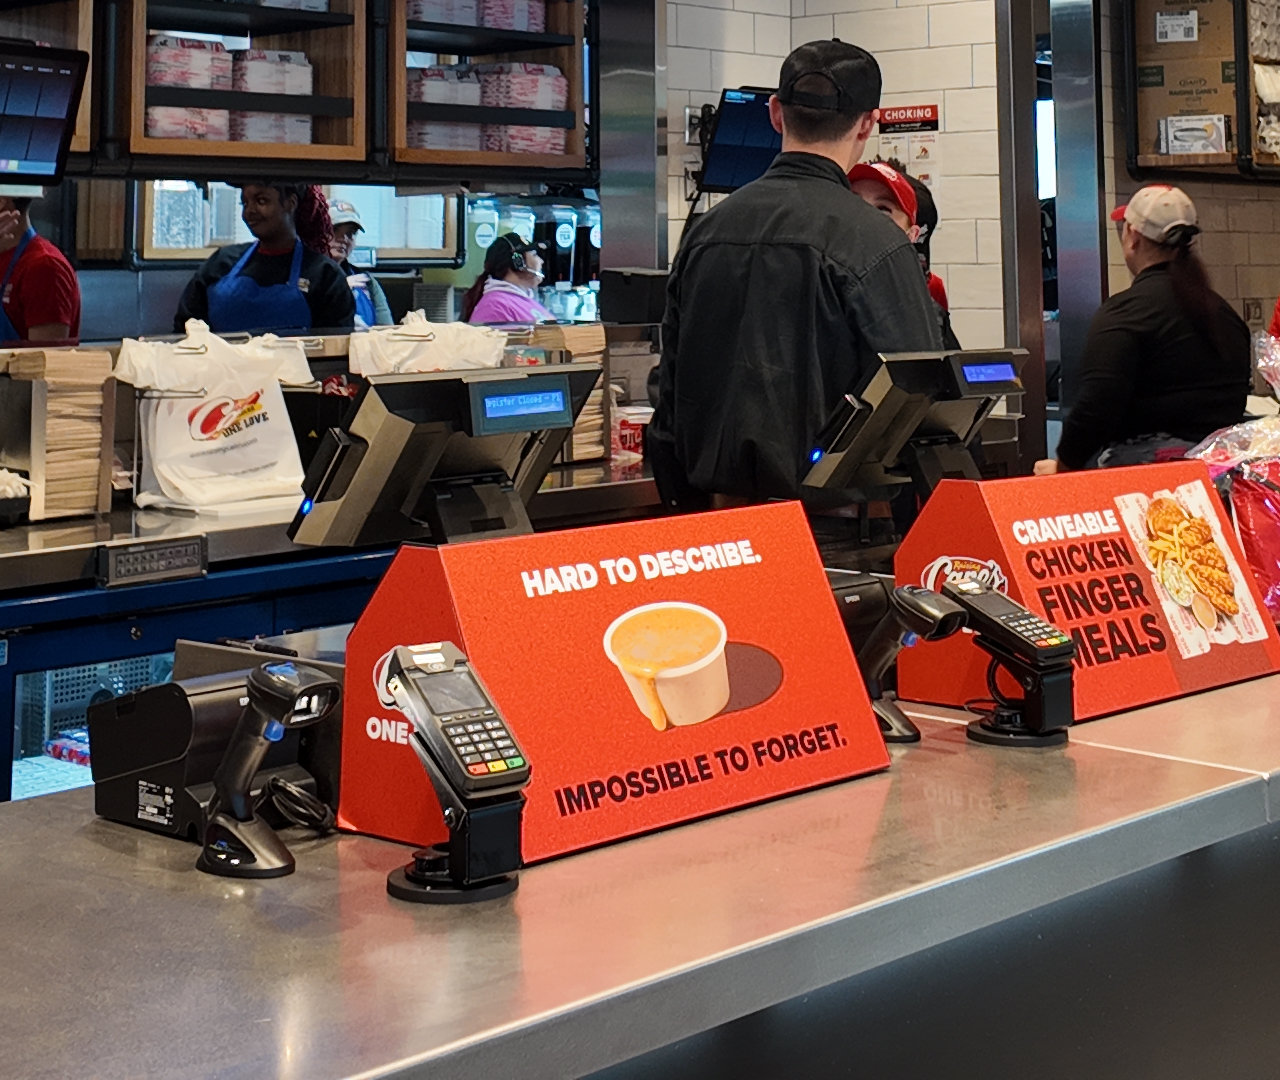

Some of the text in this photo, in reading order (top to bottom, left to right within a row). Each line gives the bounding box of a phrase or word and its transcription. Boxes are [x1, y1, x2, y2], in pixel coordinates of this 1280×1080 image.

[884, 108, 932, 120] CHOKING
[244, 411, 269, 428] LOVE
[485, 398, 514, 408] egister
[1012, 509, 1121, 546] CRAVEABLE
[521, 539, 762, 598] HARD TO DESCRIBE.
[1025, 537, 1134, 581] CHICKEN
[1035, 572, 1152, 624] FINGER
[1071, 612, 1168, 671] MEALS
[365, 716, 410, 745] ONE
[554, 723, 848, 817] IMPOSSIBLE TO FORGET.
